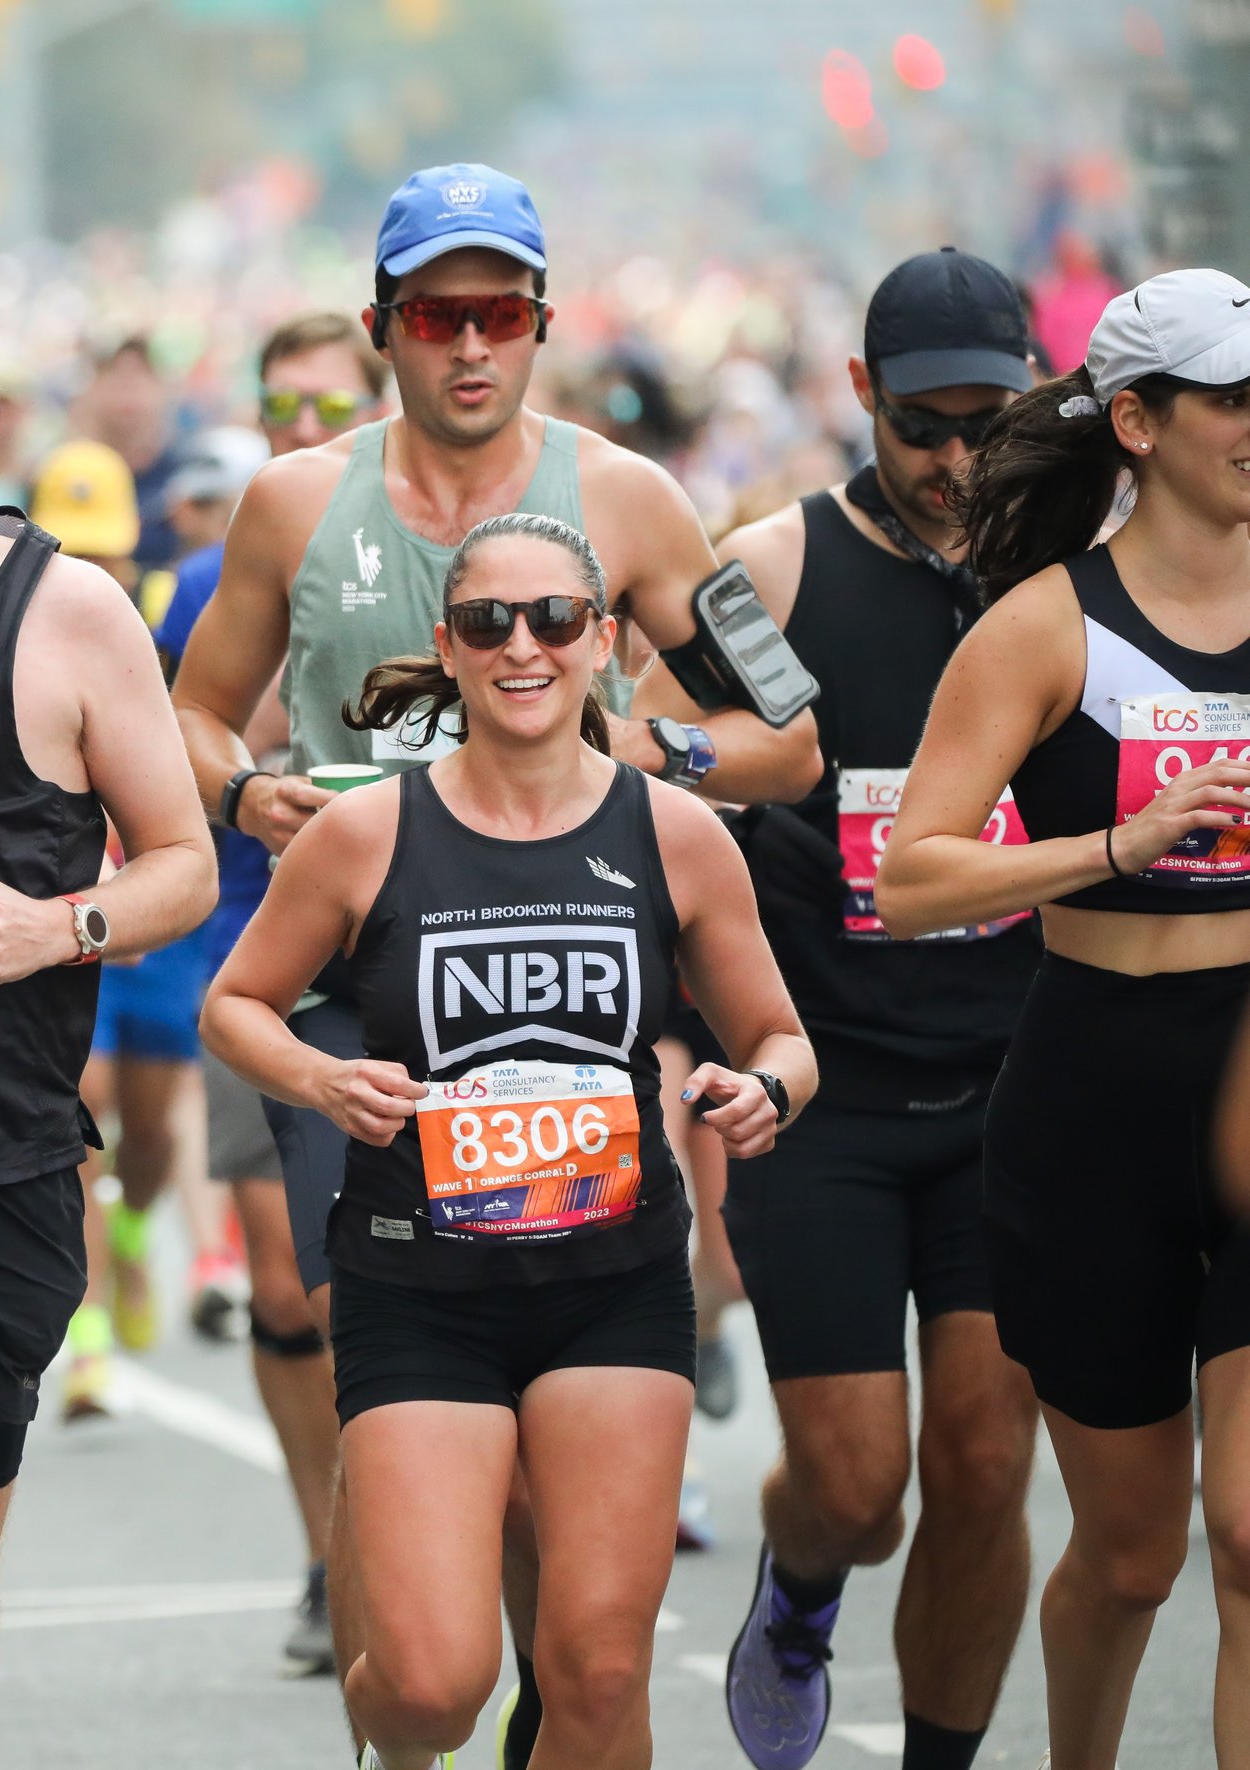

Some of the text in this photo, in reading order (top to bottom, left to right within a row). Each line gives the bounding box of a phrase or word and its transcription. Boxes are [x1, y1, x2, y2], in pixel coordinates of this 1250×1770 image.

[449, 187, 479, 198] NYC
[452, 196, 478, 204] HALF
[1204, 703, 1229, 711] TATA
[1154, 704, 1198, 732] tcs
[1205, 724, 1241, 732] SERVICES
[421, 904, 636, 925] NORTH BROOKLYN RUNNERS
[444, 952, 620, 1018] NBR
[492, 1068, 519, 1077] TATA
[493, 1076, 556, 1088] CONSULTANCY
[572, 1082, 603, 1091] TATA
[494, 1088, 534, 1097] SERVICES
[451, 1104, 610, 1171] 8306
[433, 1164, 577, 1192] WAVE 1 ORANGE CORRAL D
[584, 1208, 610, 1221] 2023
